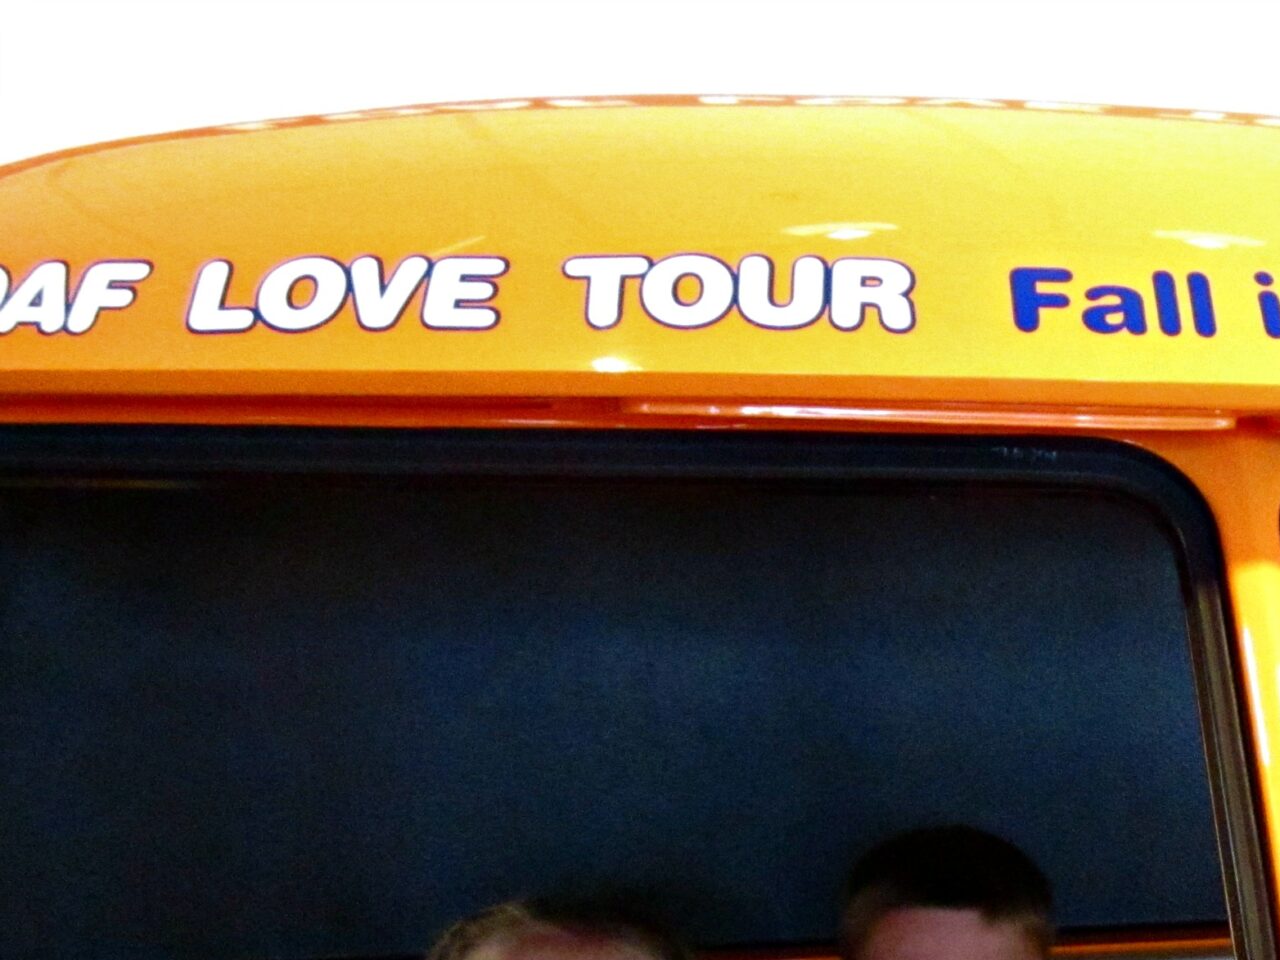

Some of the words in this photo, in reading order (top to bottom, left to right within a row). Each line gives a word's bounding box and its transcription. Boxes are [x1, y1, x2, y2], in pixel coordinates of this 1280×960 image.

[0, 257, 154, 335] AF
[185, 254, 511, 335] LOVE
[563, 252, 917, 334] TOUR
[1009, 267, 1217, 338] Fall
